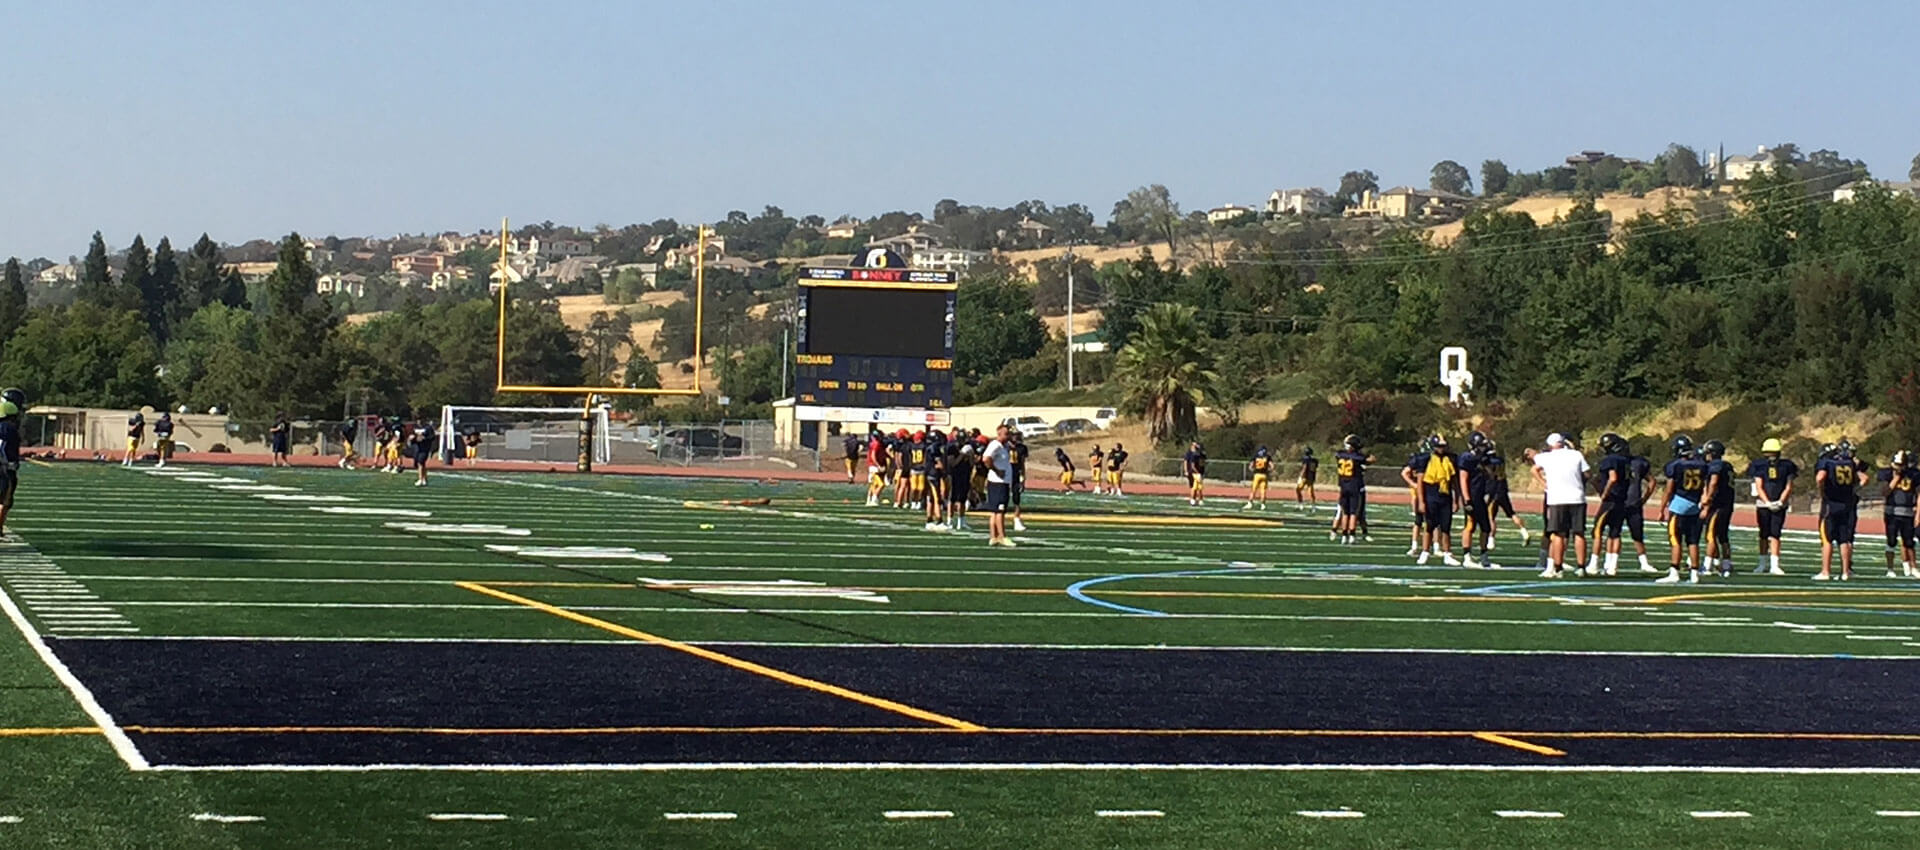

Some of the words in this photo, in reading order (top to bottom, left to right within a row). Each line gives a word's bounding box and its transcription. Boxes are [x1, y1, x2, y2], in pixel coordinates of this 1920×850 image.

[852, 270, 902, 281] BONNEY
[797, 354, 833, 364] TROJANS
[926, 359, 952, 368] GUEST
[819, 380, 839, 389] DOWN
[847, 381, 856, 389] TO
[876, 382, 893, 390] BALL
[893, 383, 903, 391] ON
[1338, 458, 1353, 476] 32
[1683, 469, 1701, 490] 65
